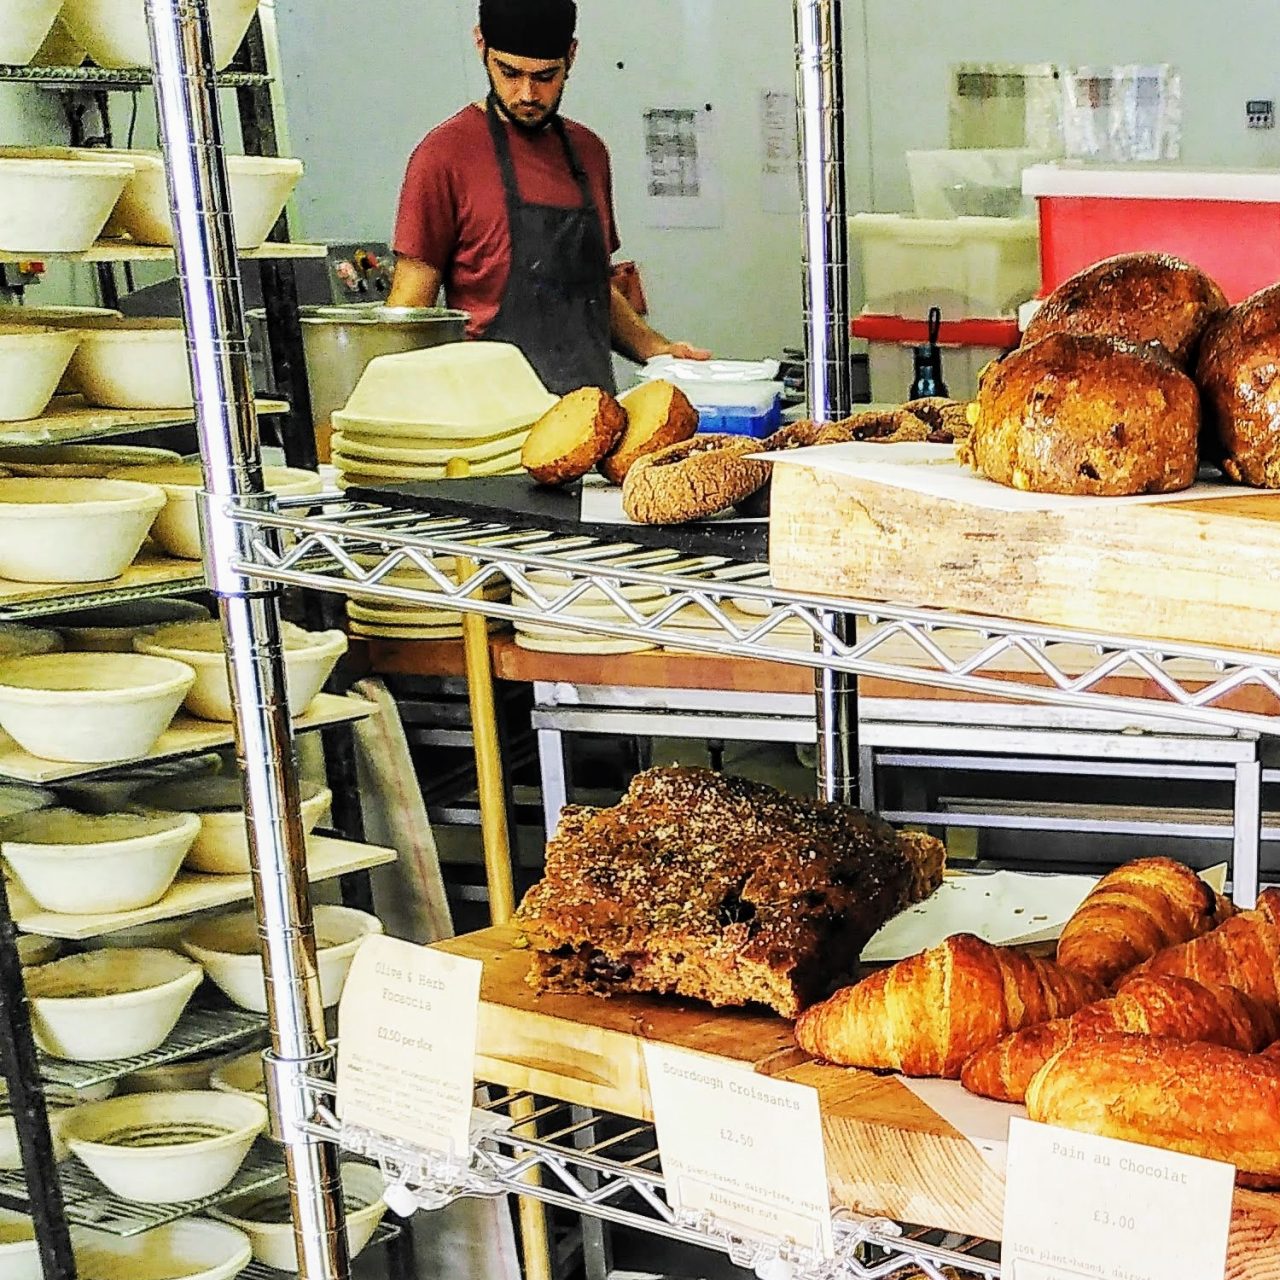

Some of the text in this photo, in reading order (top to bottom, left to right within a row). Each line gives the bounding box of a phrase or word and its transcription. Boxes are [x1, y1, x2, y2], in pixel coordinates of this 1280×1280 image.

[719, 1128, 754, 1148] £2.50
[1051, 1141, 1189, 1185] Pain au Chocolat
[1092, 1209, 1136, 1231] £3.00
